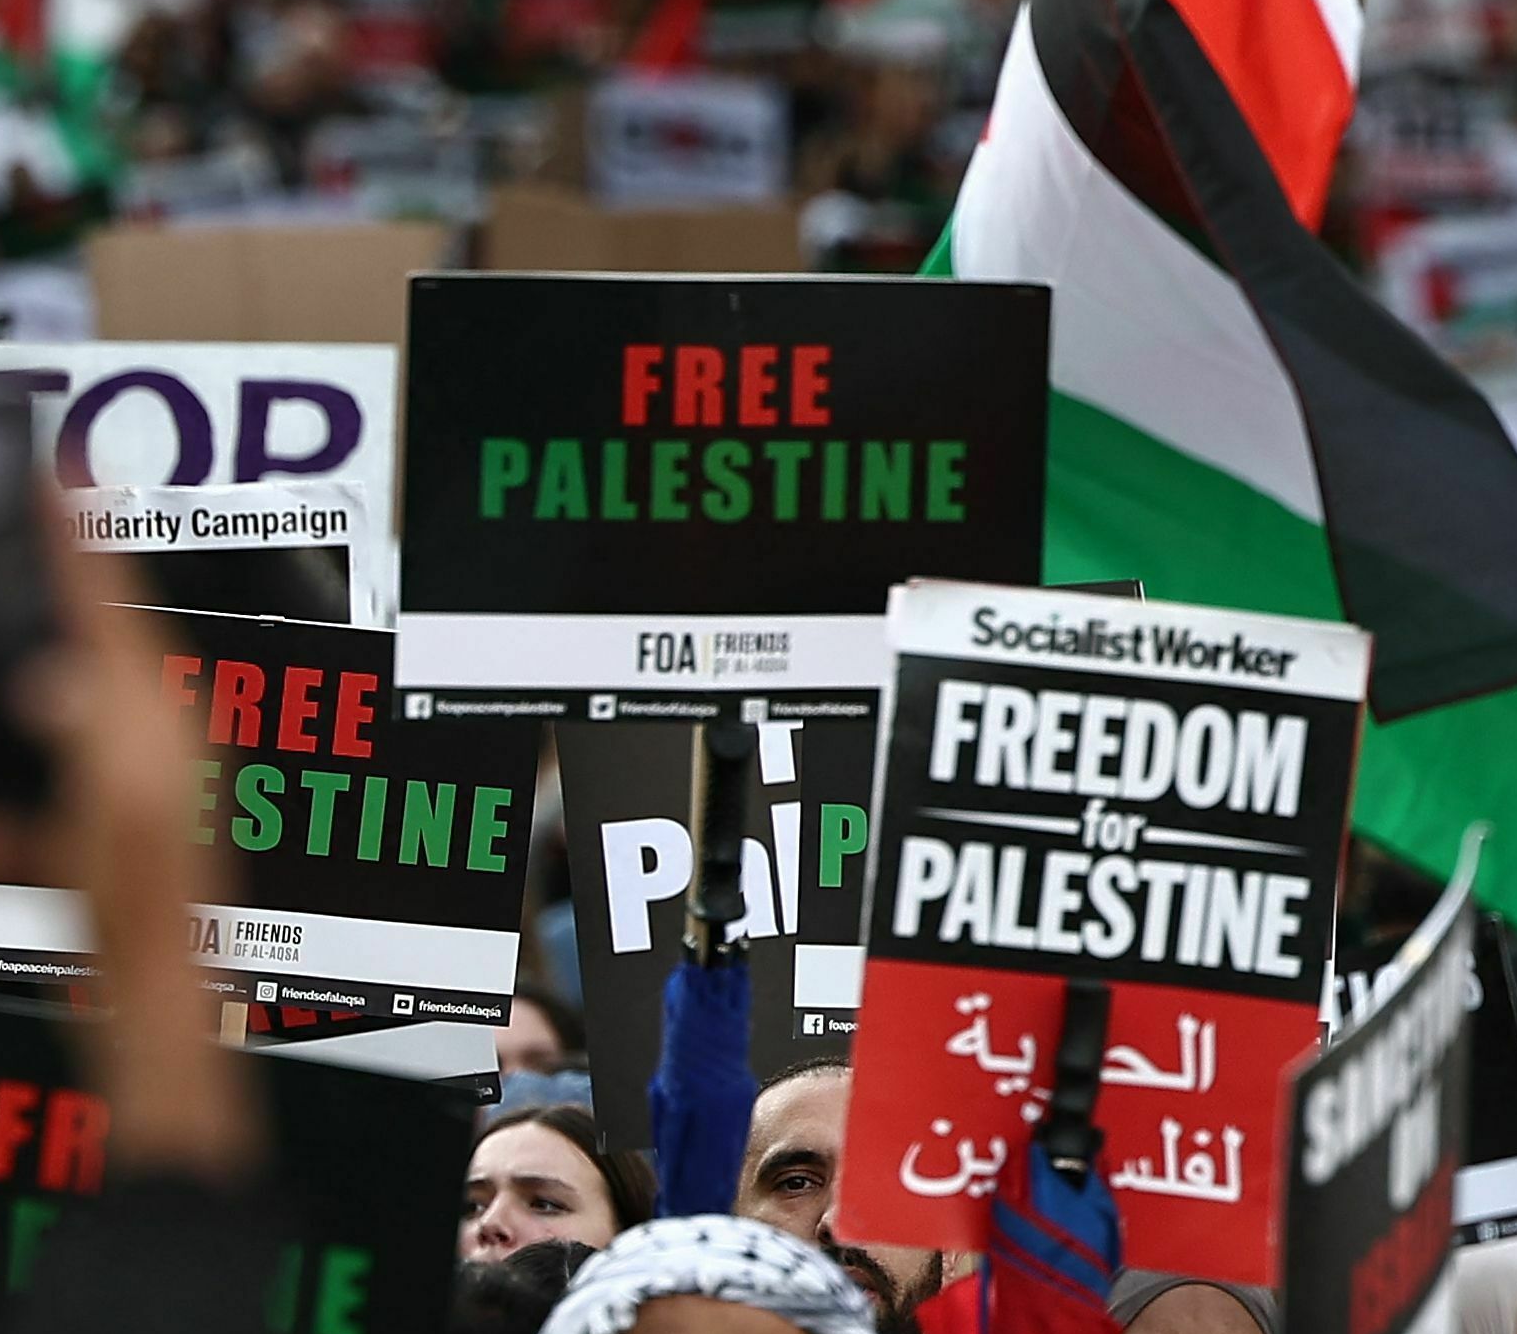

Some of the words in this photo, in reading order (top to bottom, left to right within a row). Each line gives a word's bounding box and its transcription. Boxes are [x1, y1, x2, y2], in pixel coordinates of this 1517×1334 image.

[621, 344, 832, 427] FREE
[479, 437, 967, 522] PALESTINE
[66, 506, 182, 544] lidarity
[191, 503, 348, 541] Campaign
[636, 631, 698, 675] FOA
[970, 606, 1144, 664] Socialist
[1152, 627, 1299, 681] Worker
[161, 652, 380, 760] FREE
[929, 678, 1310, 819] FREEDOM
[189, 761, 514, 875] ESTINE
[1083, 798, 1145, 852] for
[186, 915, 222, 956] OA
[235, 919, 304, 948] FRIENDS
[892, 834, 1312, 980] PALESTINE
[250, 942, 301, 964] AL-AQSA
[281, 985, 367, 1008] friendsofalaqsa
[418, 998, 502, 1020] friendsofalaqsa
[945, 991, 1218, 1097] الحية
[899, 1115, 1246, 1206] لفلسين
